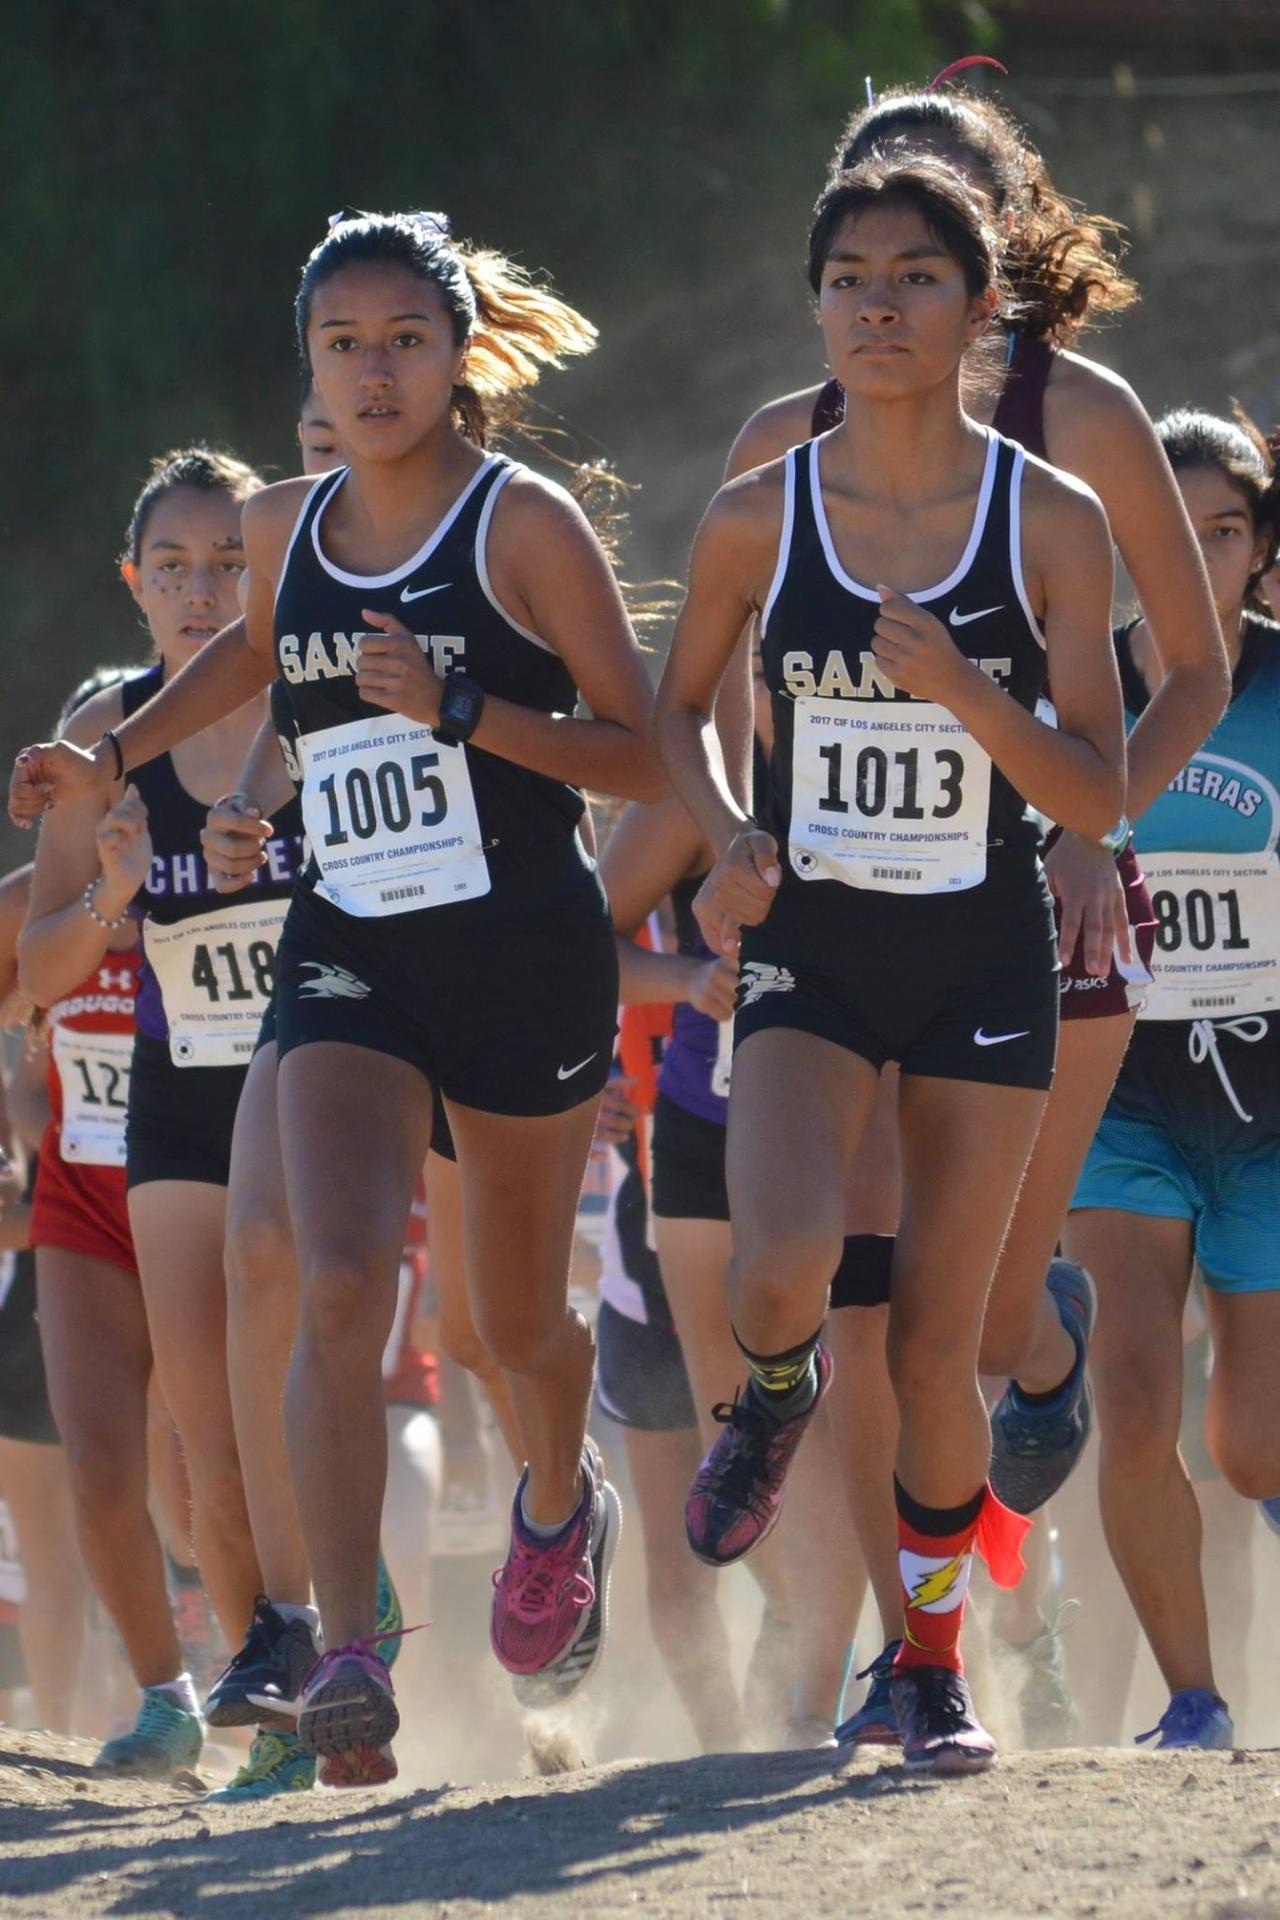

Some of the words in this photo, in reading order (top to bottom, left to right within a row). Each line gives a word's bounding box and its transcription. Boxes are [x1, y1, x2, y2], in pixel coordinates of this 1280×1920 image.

[279, 631, 466, 684] SANE
[783, 650, 1012, 699] SANE
[350, 736, 385, 752] ANGELES
[386, 733, 408, 745] CITY
[810, 714, 831, 725] 2017
[834, 717, 848, 727] CIF
[851, 719, 868, 730] LOS
[870, 721, 912, 732] ANGELES
[915, 723, 935, 733] CITY
[319, 752, 449, 847] 1005
[818, 742, 965, 820] 1013
[322, 858, 349, 872] CROSS
[350, 851, 385, 867] COUNTRY
[387, 835, 465, 859] CHAMPIONSHIPS
[808, 823, 839, 837] CROSS
[841, 828, 887, 842] COUNTRY
[889, 831, 969, 843] CHAMPIONSHIPS
[1151, 888, 1250, 952] 801
[191, 940, 275, 1002] 418
[1074, 975, 1108, 990] asics
[1164, 964, 1203, 973] COUNTRY
[1205, 958, 1277, 972] CHAMPIONSHIPS
